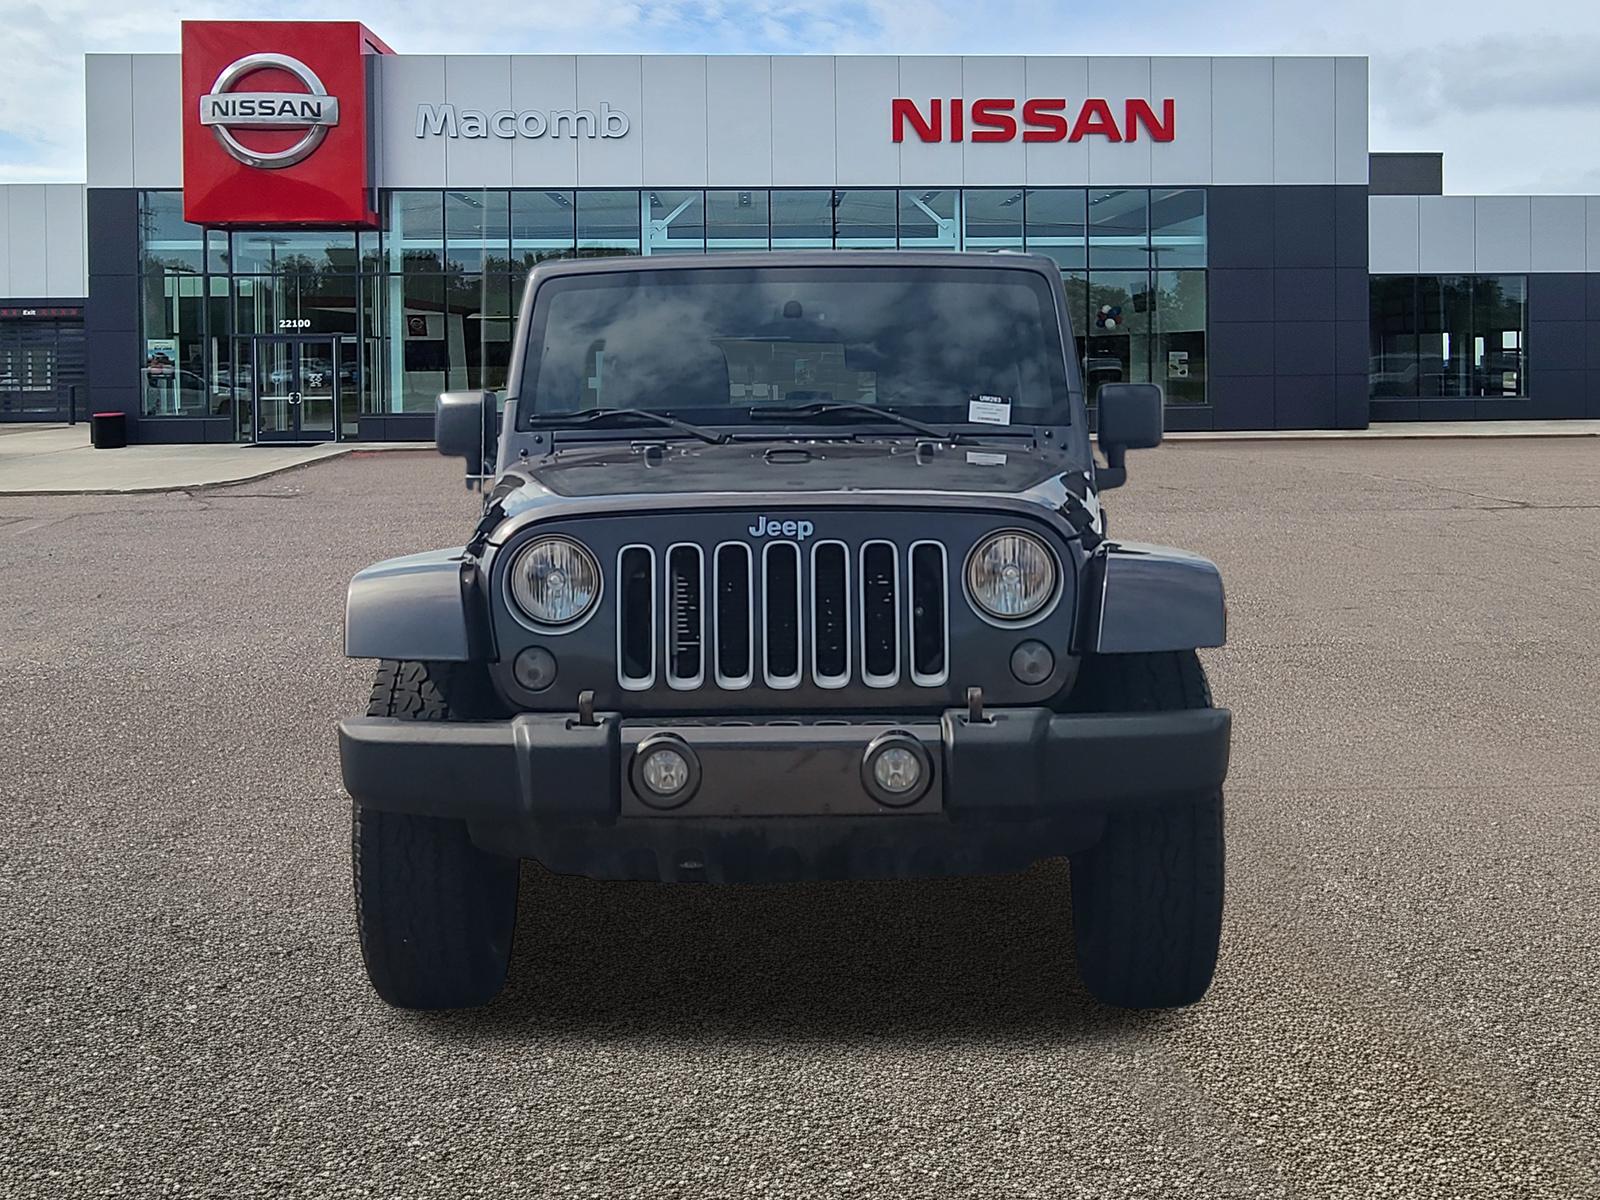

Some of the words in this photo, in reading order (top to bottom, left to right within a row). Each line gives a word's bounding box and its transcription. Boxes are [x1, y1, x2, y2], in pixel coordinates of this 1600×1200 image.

[212, 100, 321, 117] NISSAN
[415, 102, 630, 138] Macomb
[891, 98, 1175, 143] NISSAN
[279, 319, 311, 328] 22100
[748, 516, 814, 541] Jeep
